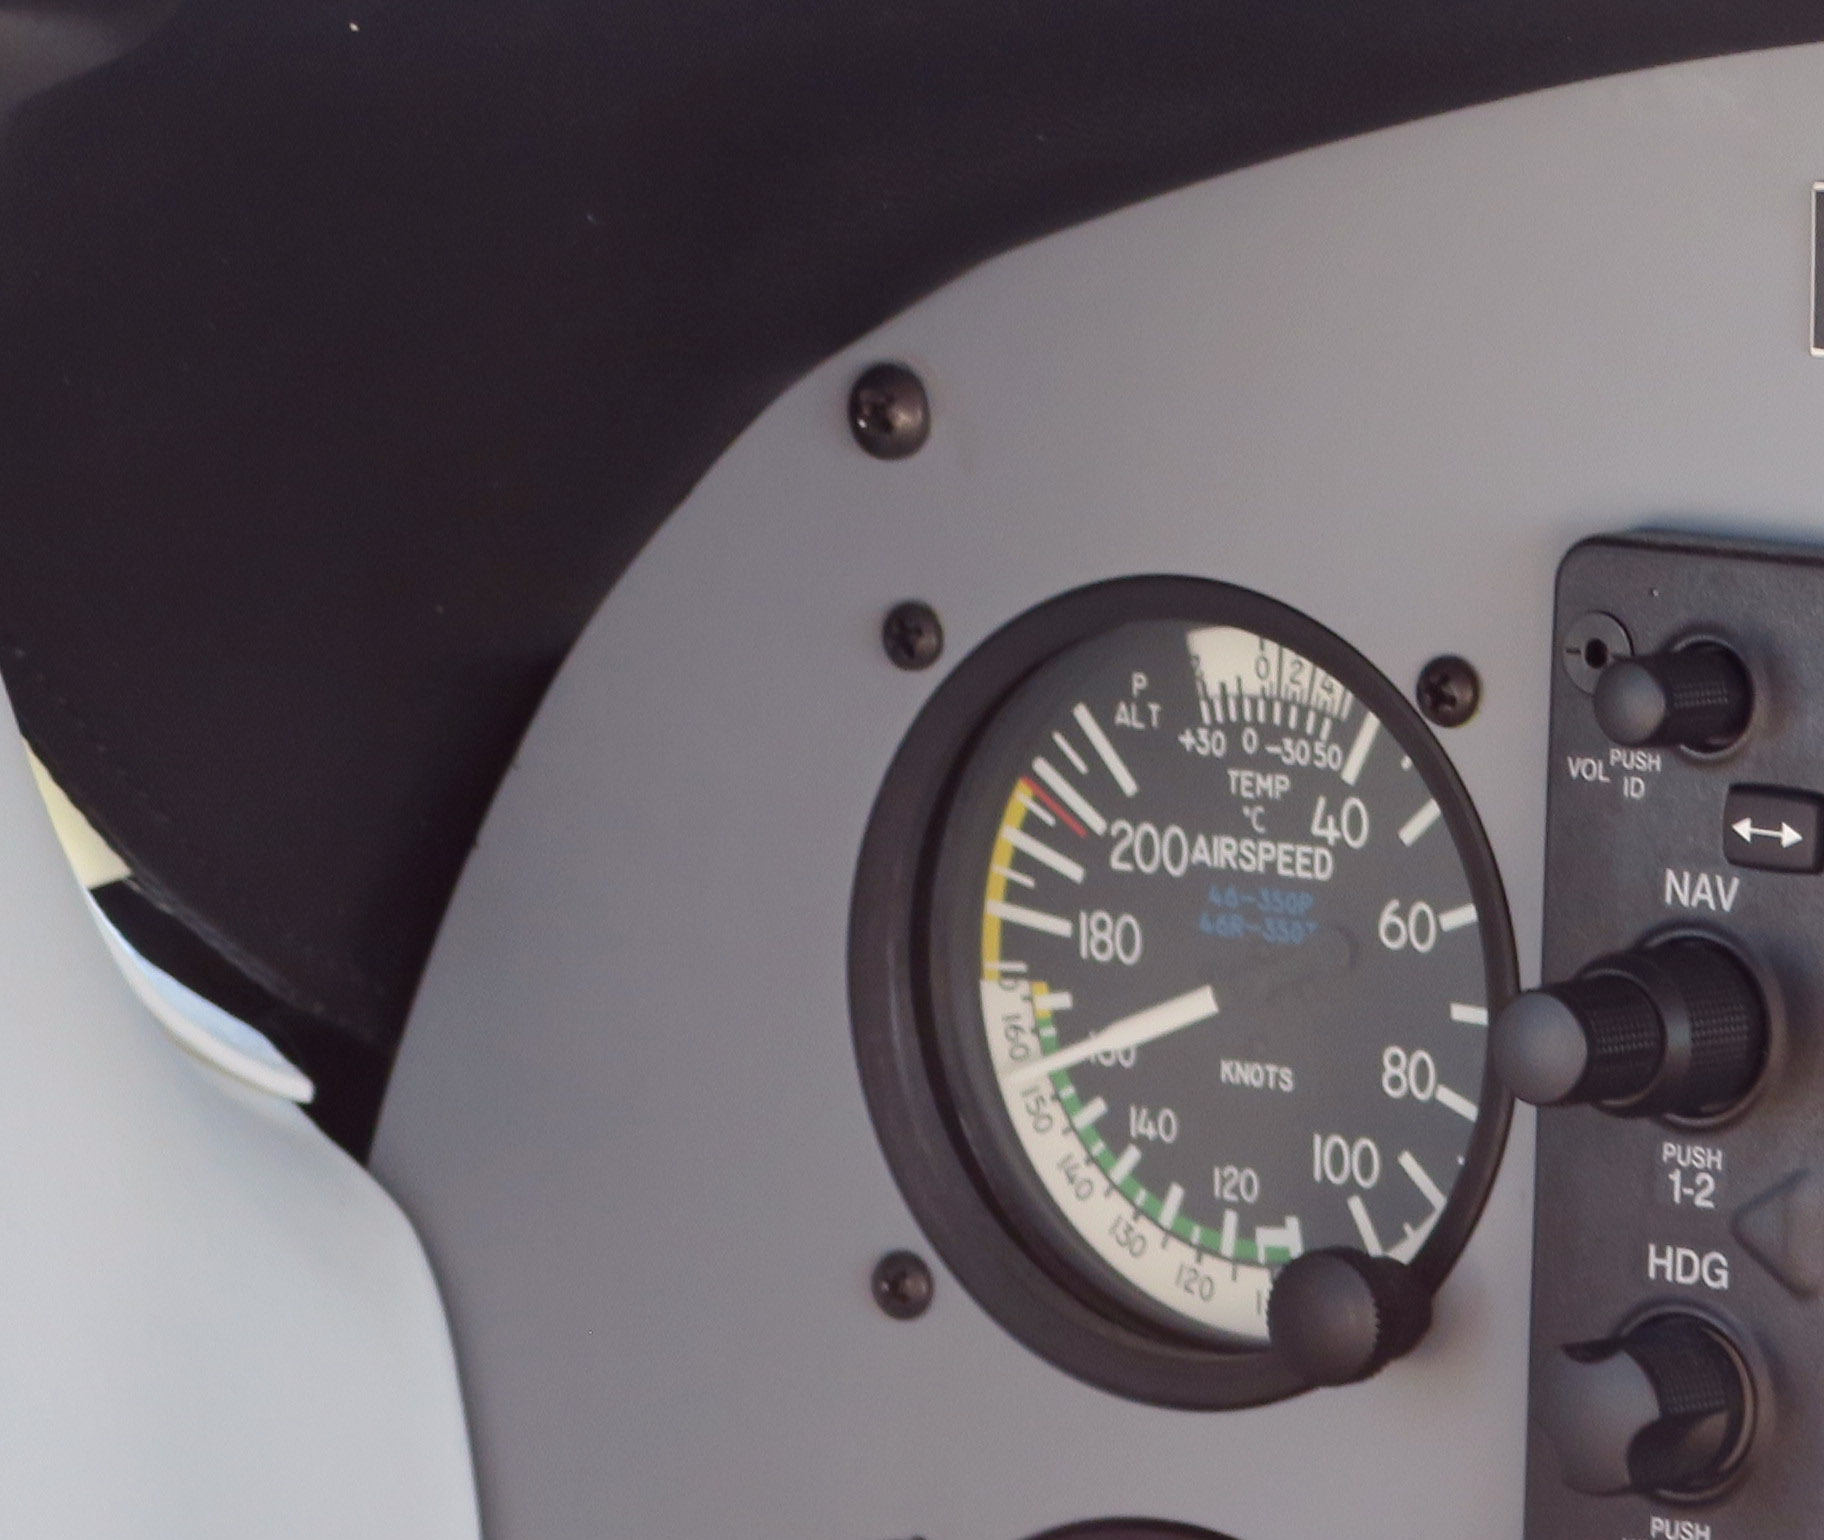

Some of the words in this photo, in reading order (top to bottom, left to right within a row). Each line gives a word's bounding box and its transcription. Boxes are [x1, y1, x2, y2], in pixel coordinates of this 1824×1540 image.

[1115, 702, 1161, 730] ALT
[1568, 757, 1609, 783] VOL
[1610, 748, 1661, 774] PUSH
[1227, 767, 1291, 800] TEMP
[1623, 776, 1646, 799] ID
[1311, 796, 1369, 850] 40
[1110, 824, 1188, 878] 200
[1191, 832, 1334, 882] AIRSPEED
[1664, 868, 1739, 912] NAV
[1080, 913, 1142, 964] 180
[1379, 900, 1438, 952] 60
[1221, 1060, 1295, 1093] KNOTS
[1382, 1048, 1438, 1101] 80
[1129, 1107, 1177, 1143] 140
[1313, 1136, 1379, 1188] 100
[1662, 1142, 1722, 1170] PUSH
[1212, 1165, 1259, 1203] 120
[1648, 1244, 1728, 1289] HDG
